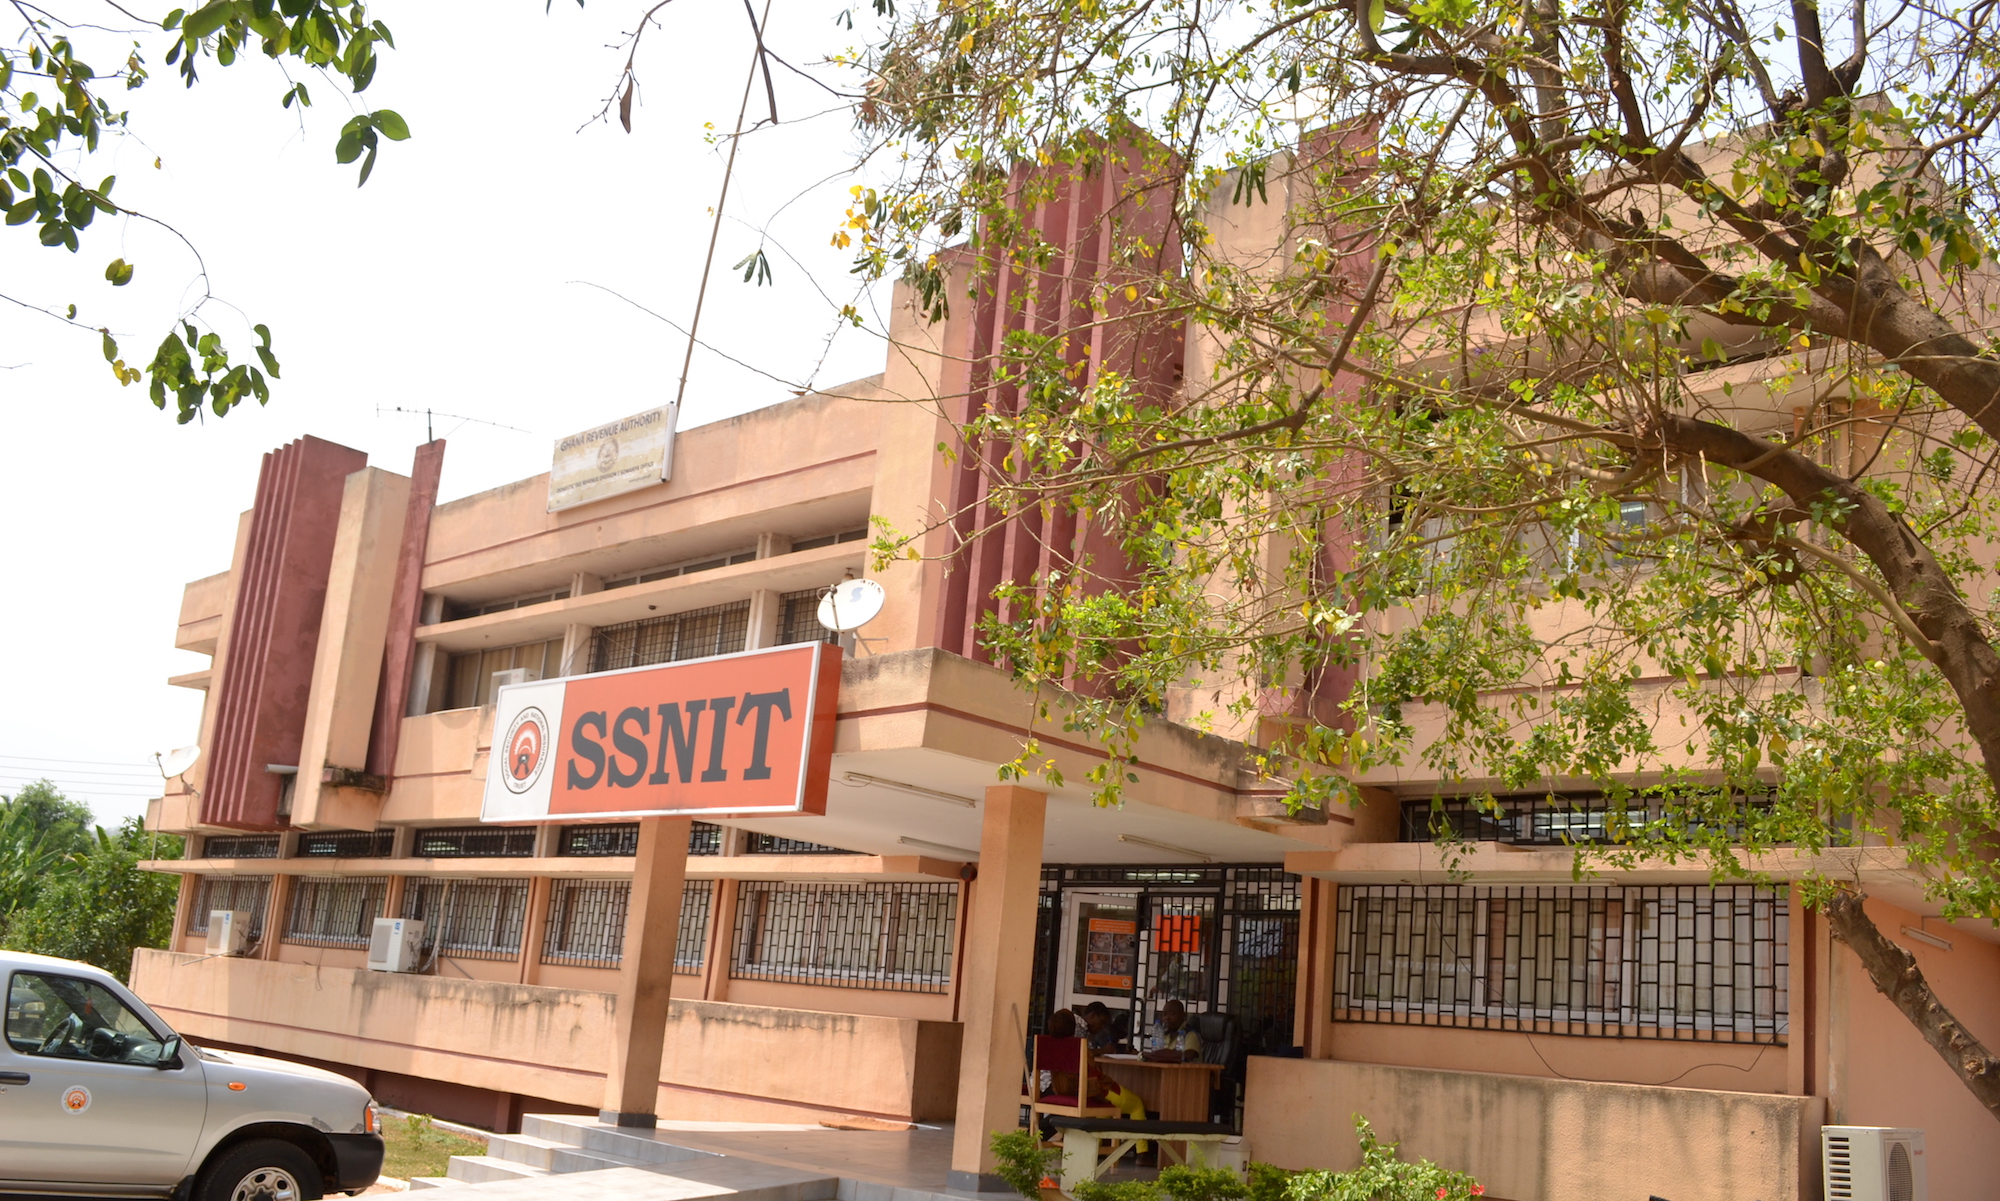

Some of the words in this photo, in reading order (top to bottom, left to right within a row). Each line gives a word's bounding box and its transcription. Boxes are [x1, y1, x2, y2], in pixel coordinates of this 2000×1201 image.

[560, 436, 585, 452] GHANA
[586, 424, 619, 442] REVENUE
[619, 411, 662, 432] AUTHORITY
[520, 713, 530, 722] AND
[530, 712, 546, 732] NATIONAL
[504, 722, 520, 753] SECURITY
[567, 688, 792, 791] SSNIT
[534, 733, 547, 776] INSURANCE
[503, 757, 511, 780] SOCIAL
[513, 781, 527, 790] TRUST
